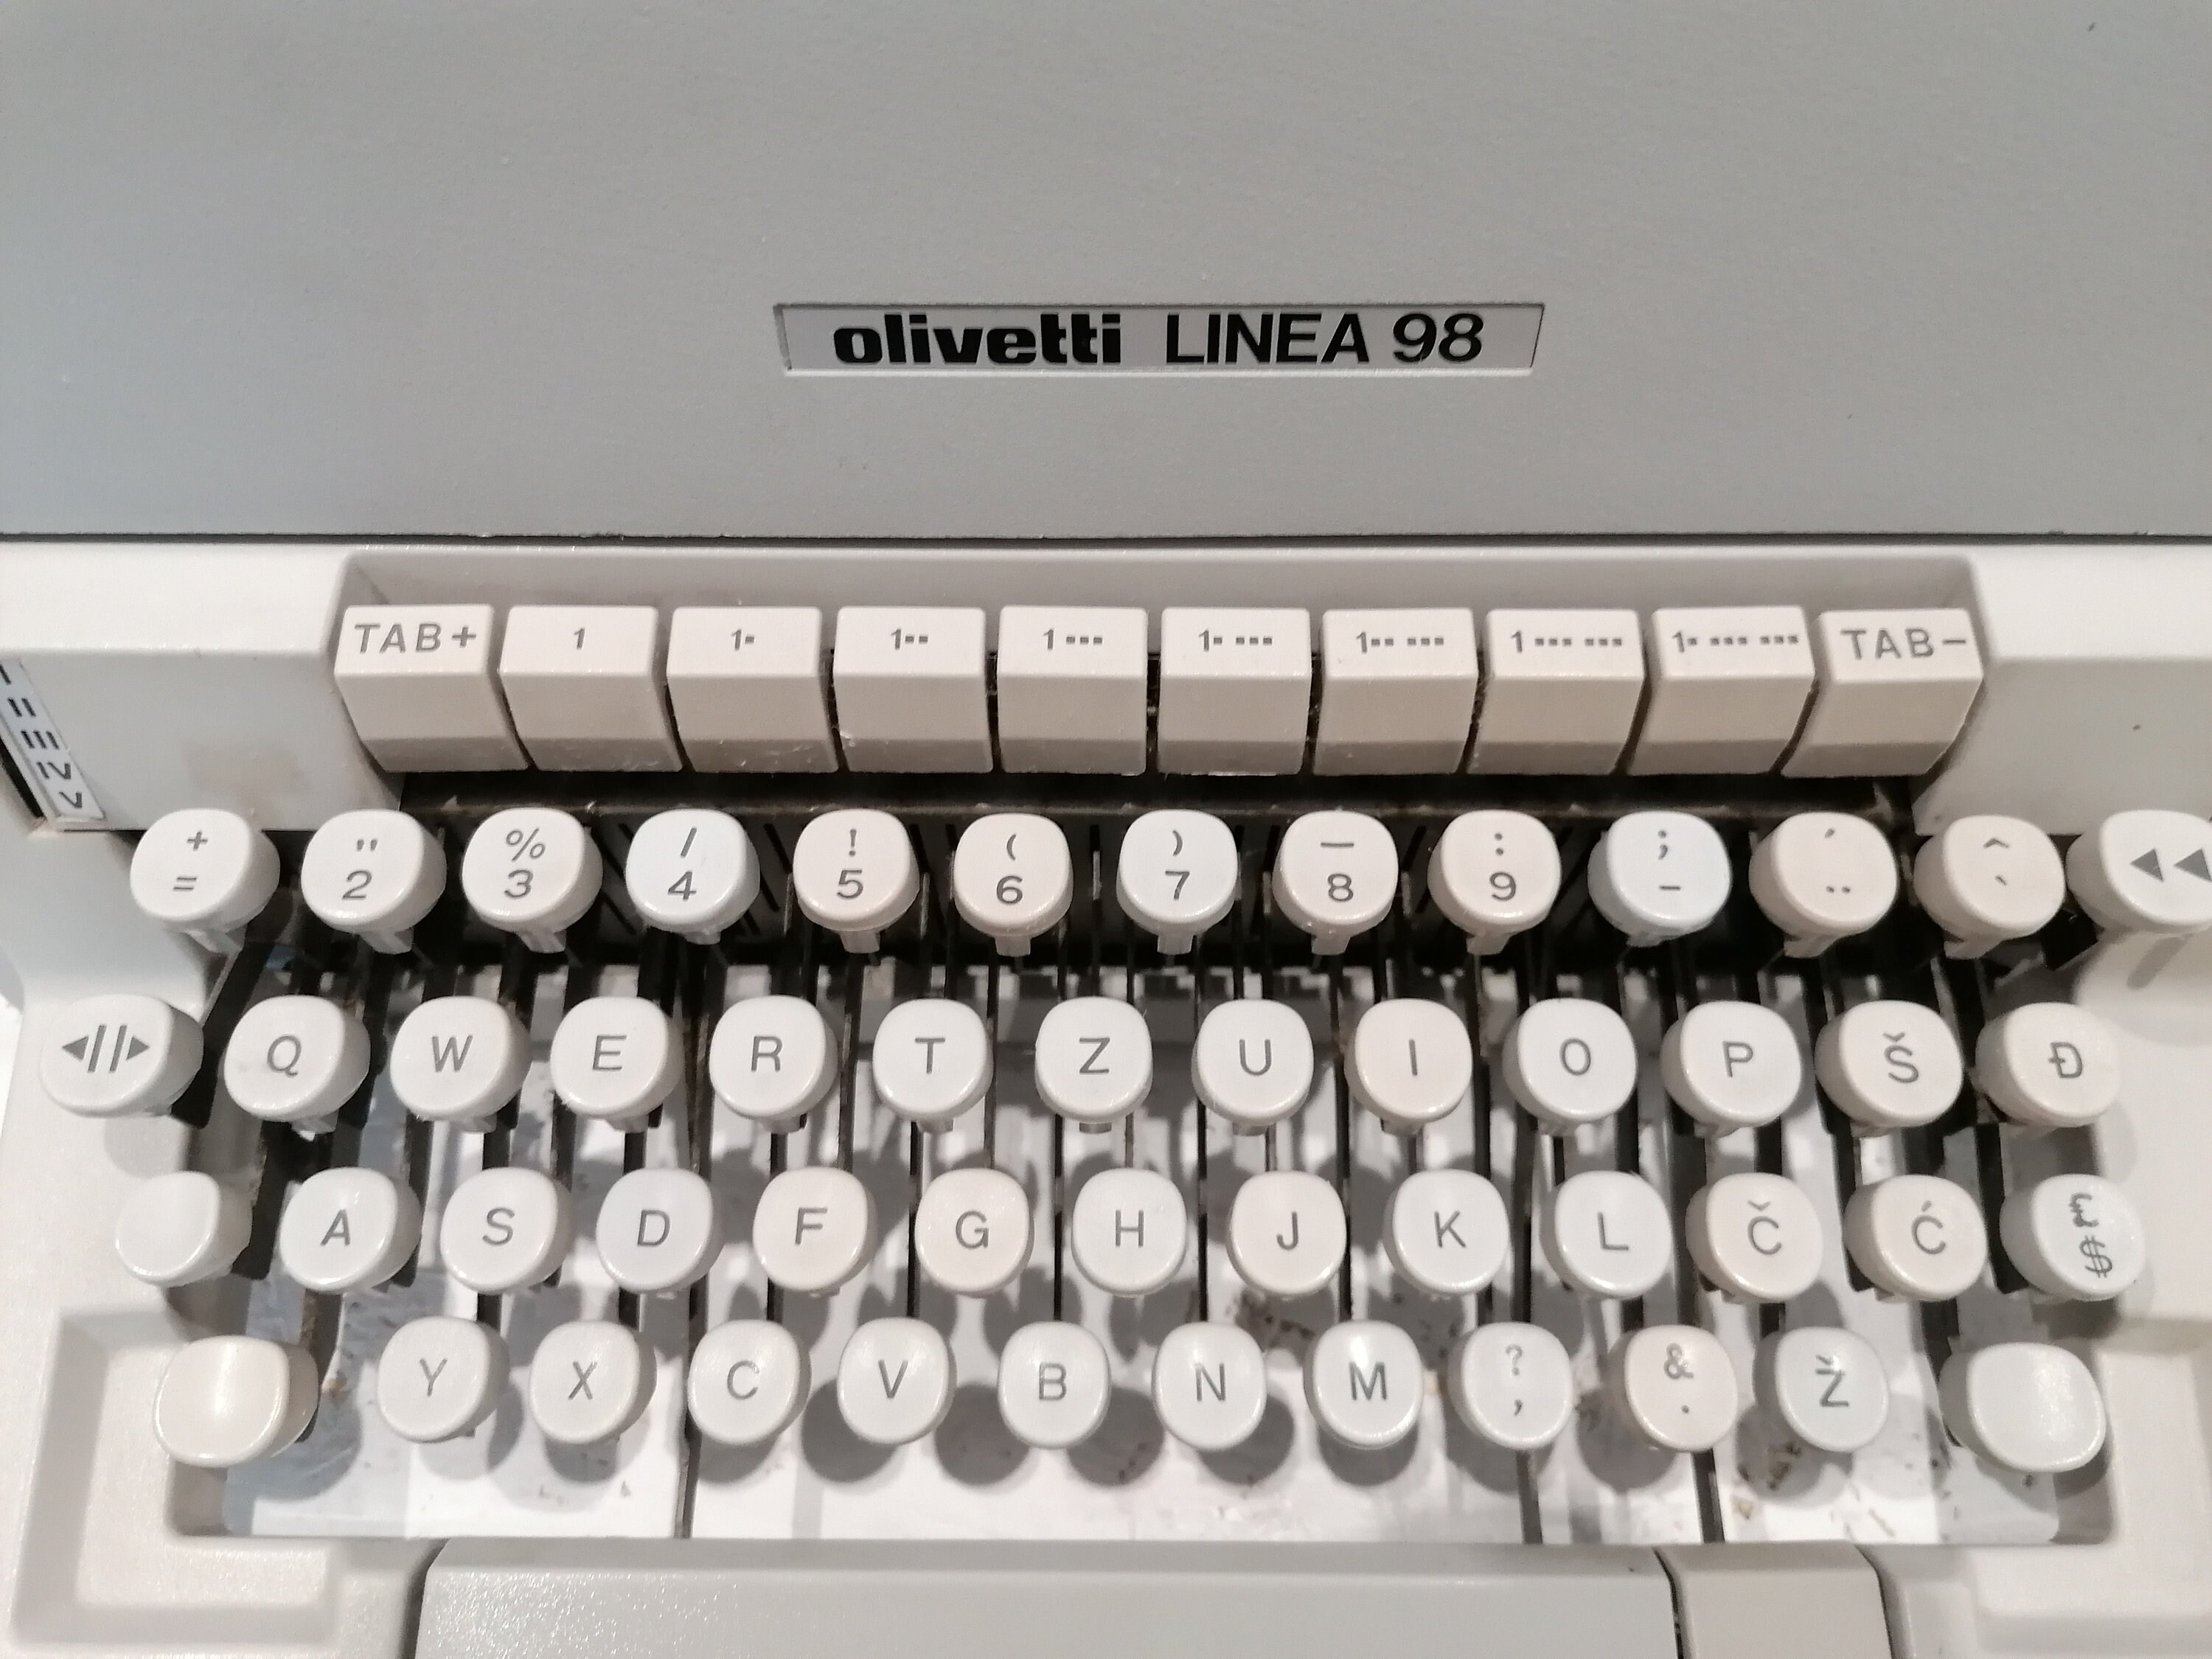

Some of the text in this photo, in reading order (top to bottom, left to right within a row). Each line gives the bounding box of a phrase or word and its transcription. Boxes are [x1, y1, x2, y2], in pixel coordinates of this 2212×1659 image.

[832, 313, 1484, 364] olivetti LINEA 98
[7, 698, 36, 717] II
[20, 729, 60, 750] III
[37, 761, 72, 780] IV
[59, 791, 83, 809] V
[505, 827, 546, 862] %
[341, 869, 372, 900] 2
[504, 869, 534, 900] 3
[667, 871, 697, 901] 4
[836, 869, 864, 900] 5
[996, 874, 1023, 905] 6
[1164, 870, 1190, 901] 7
[1327, 873, 1354, 903] 8
[1489, 871, 1517, 902] 9
[266, 1034, 302, 1078] Q
[431, 1034, 473, 1073] W
[591, 1034, 627, 1072] E
[751, 1035, 783, 1073] R
[914, 1037, 946, 1074] T
[1079, 1037, 1110, 1075] Z
[1239, 1039, 1272, 1077] U
[1408, 1039, 1419, 1077] I
[1559, 1037, 1592, 1077] O
[1722, 1040, 1754, 1078] P
[1882, 1032, 1919, 1085] Š
[2048, 1041, 2084, 1079] Đ
[320, 1209, 351, 1247] A
[481, 1207, 515, 1247] S
[636, 1208, 670, 1248] D
[794, 1207, 828, 1246] F
[955, 1209, 990, 1251] G
[1115, 1209, 1144, 1248] H
[1276, 1211, 1299, 1251] J
[1433, 1211, 1467, 1249] K
[1597, 1211, 1630, 1252] L
[1747, 1200, 1782, 1256] Č
[1910, 1200, 1947, 1256] Ć
[2079, 1235, 2113, 1279] $
[419, 1357, 448, 1397] Y
[1504, 1343, 1524, 1377] ?
[1663, 1343, 1694, 1381] &
[568, 1361, 597, 1400] X
[726, 1360, 758, 1401] C
[877, 1360, 908, 1400] V
[1038, 1363, 1068, 1402] B
[1195, 1363, 1226, 1402] N
[1349, 1362, 1388, 1401] M
[1815, 1354, 1850, 1408] Ž
